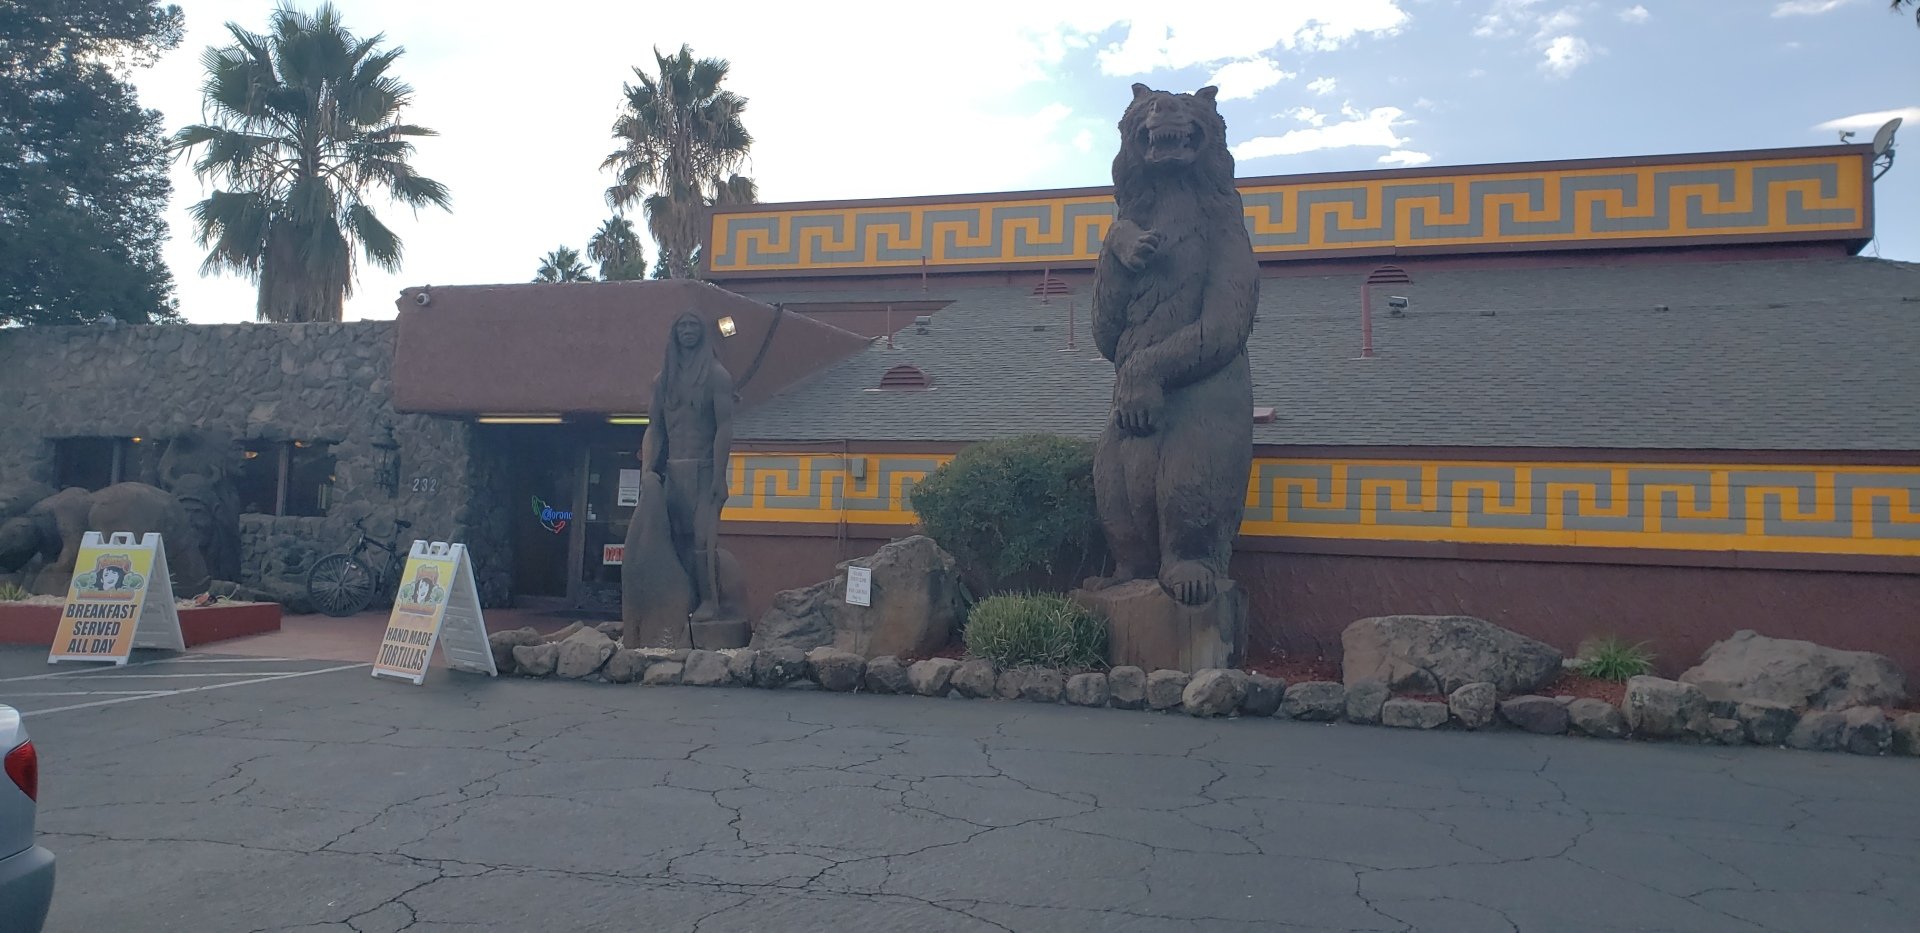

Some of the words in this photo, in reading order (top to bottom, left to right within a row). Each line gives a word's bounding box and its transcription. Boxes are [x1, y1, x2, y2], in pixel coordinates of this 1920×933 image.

[412, 478, 437, 491] 232
[66, 603, 137, 619] BREAKFAST
[72, 621, 121, 636] SERVED
[385, 627, 408, 643] HAND
[408, 631, 433, 646] MADE
[67, 638, 89, 653] ALL
[91, 638, 117, 654] DAY
[379, 643, 427, 671] TORTILLAS
